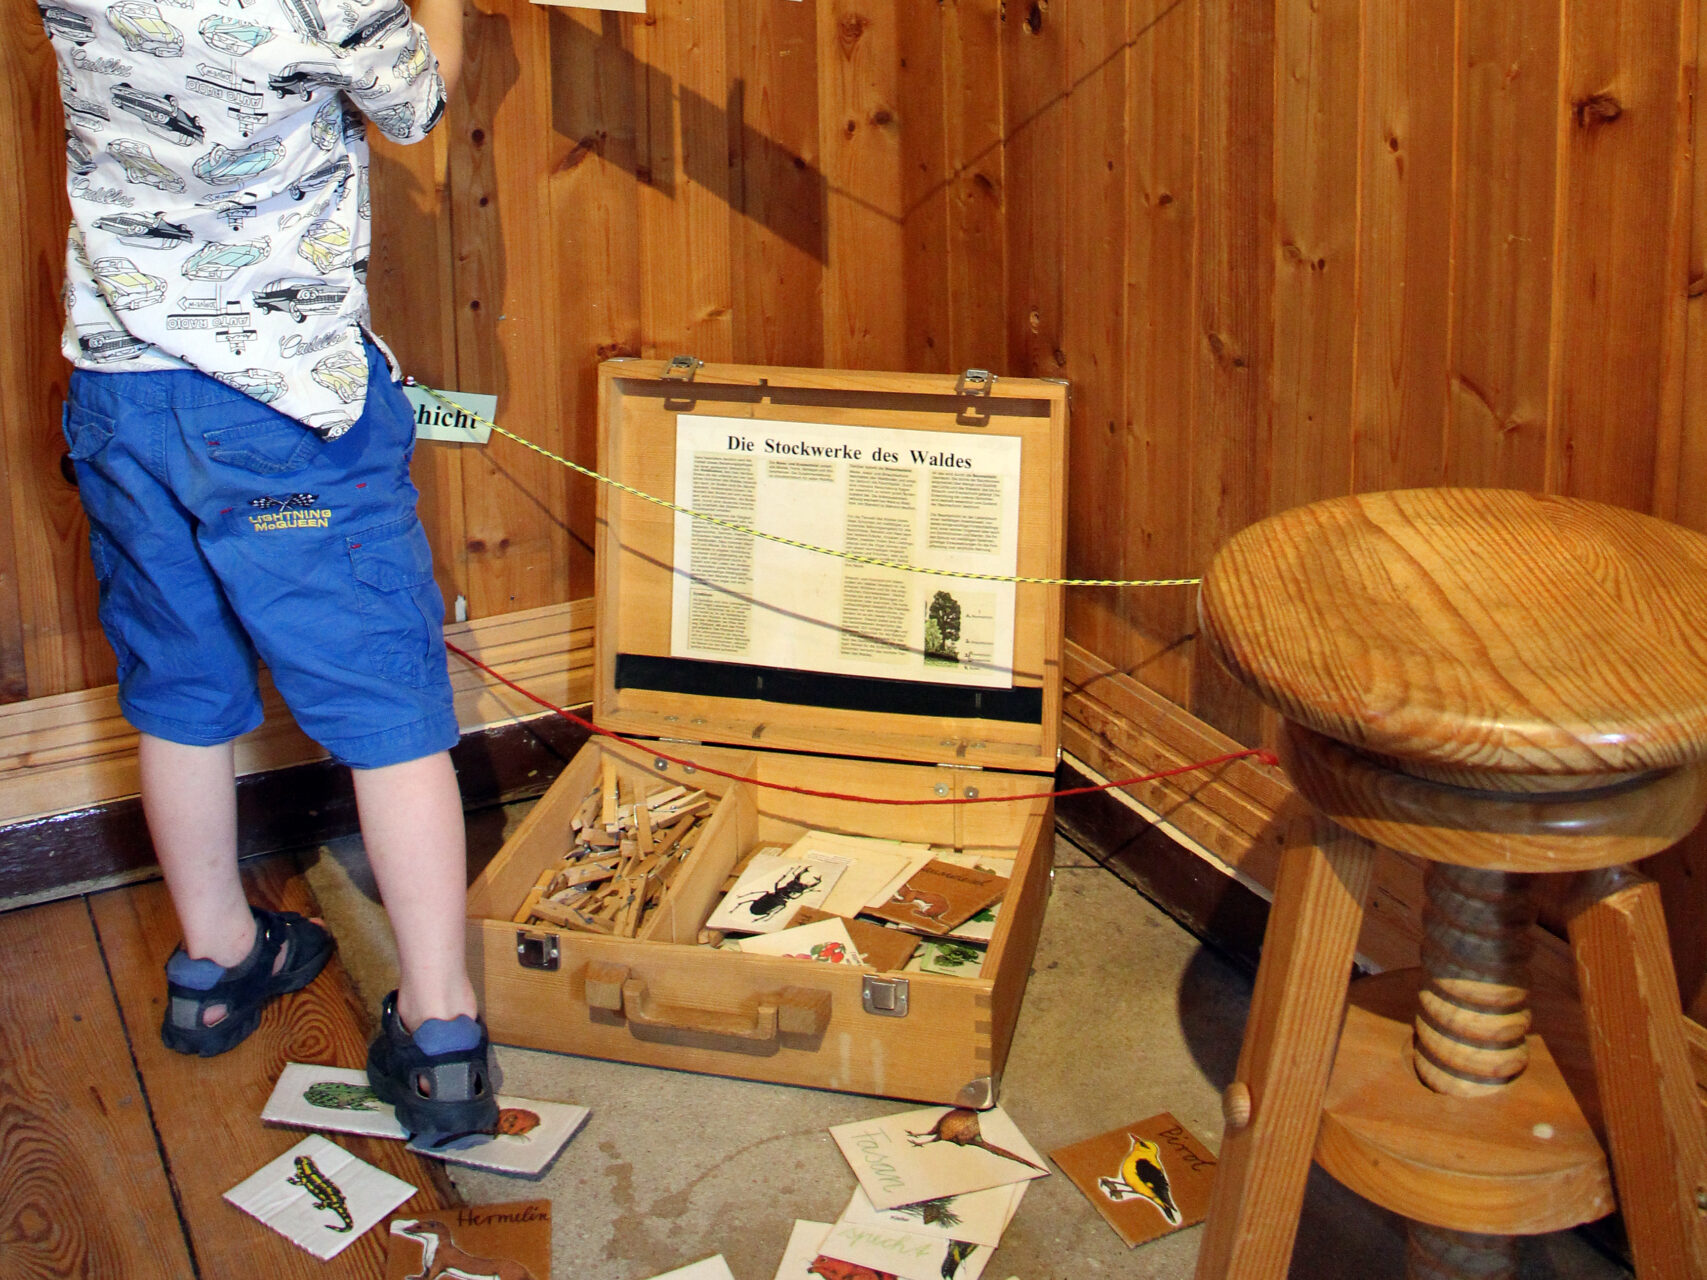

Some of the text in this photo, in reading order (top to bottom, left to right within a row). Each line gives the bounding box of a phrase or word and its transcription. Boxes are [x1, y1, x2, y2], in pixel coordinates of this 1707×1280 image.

[187, 79, 262, 108] AUTO RADIO
[167, 316, 250, 329] AUTO RADIO
[413, 403, 479, 430] hicht
[727, 434, 973, 470] Die Stockwerke des Waldes
[248, 508, 332, 524] LIGHTNING
[851, 1127, 905, 1193] Fasan
[1158, 1124, 1217, 1172] Pirol
[456, 1205, 549, 1228] Hermelin
